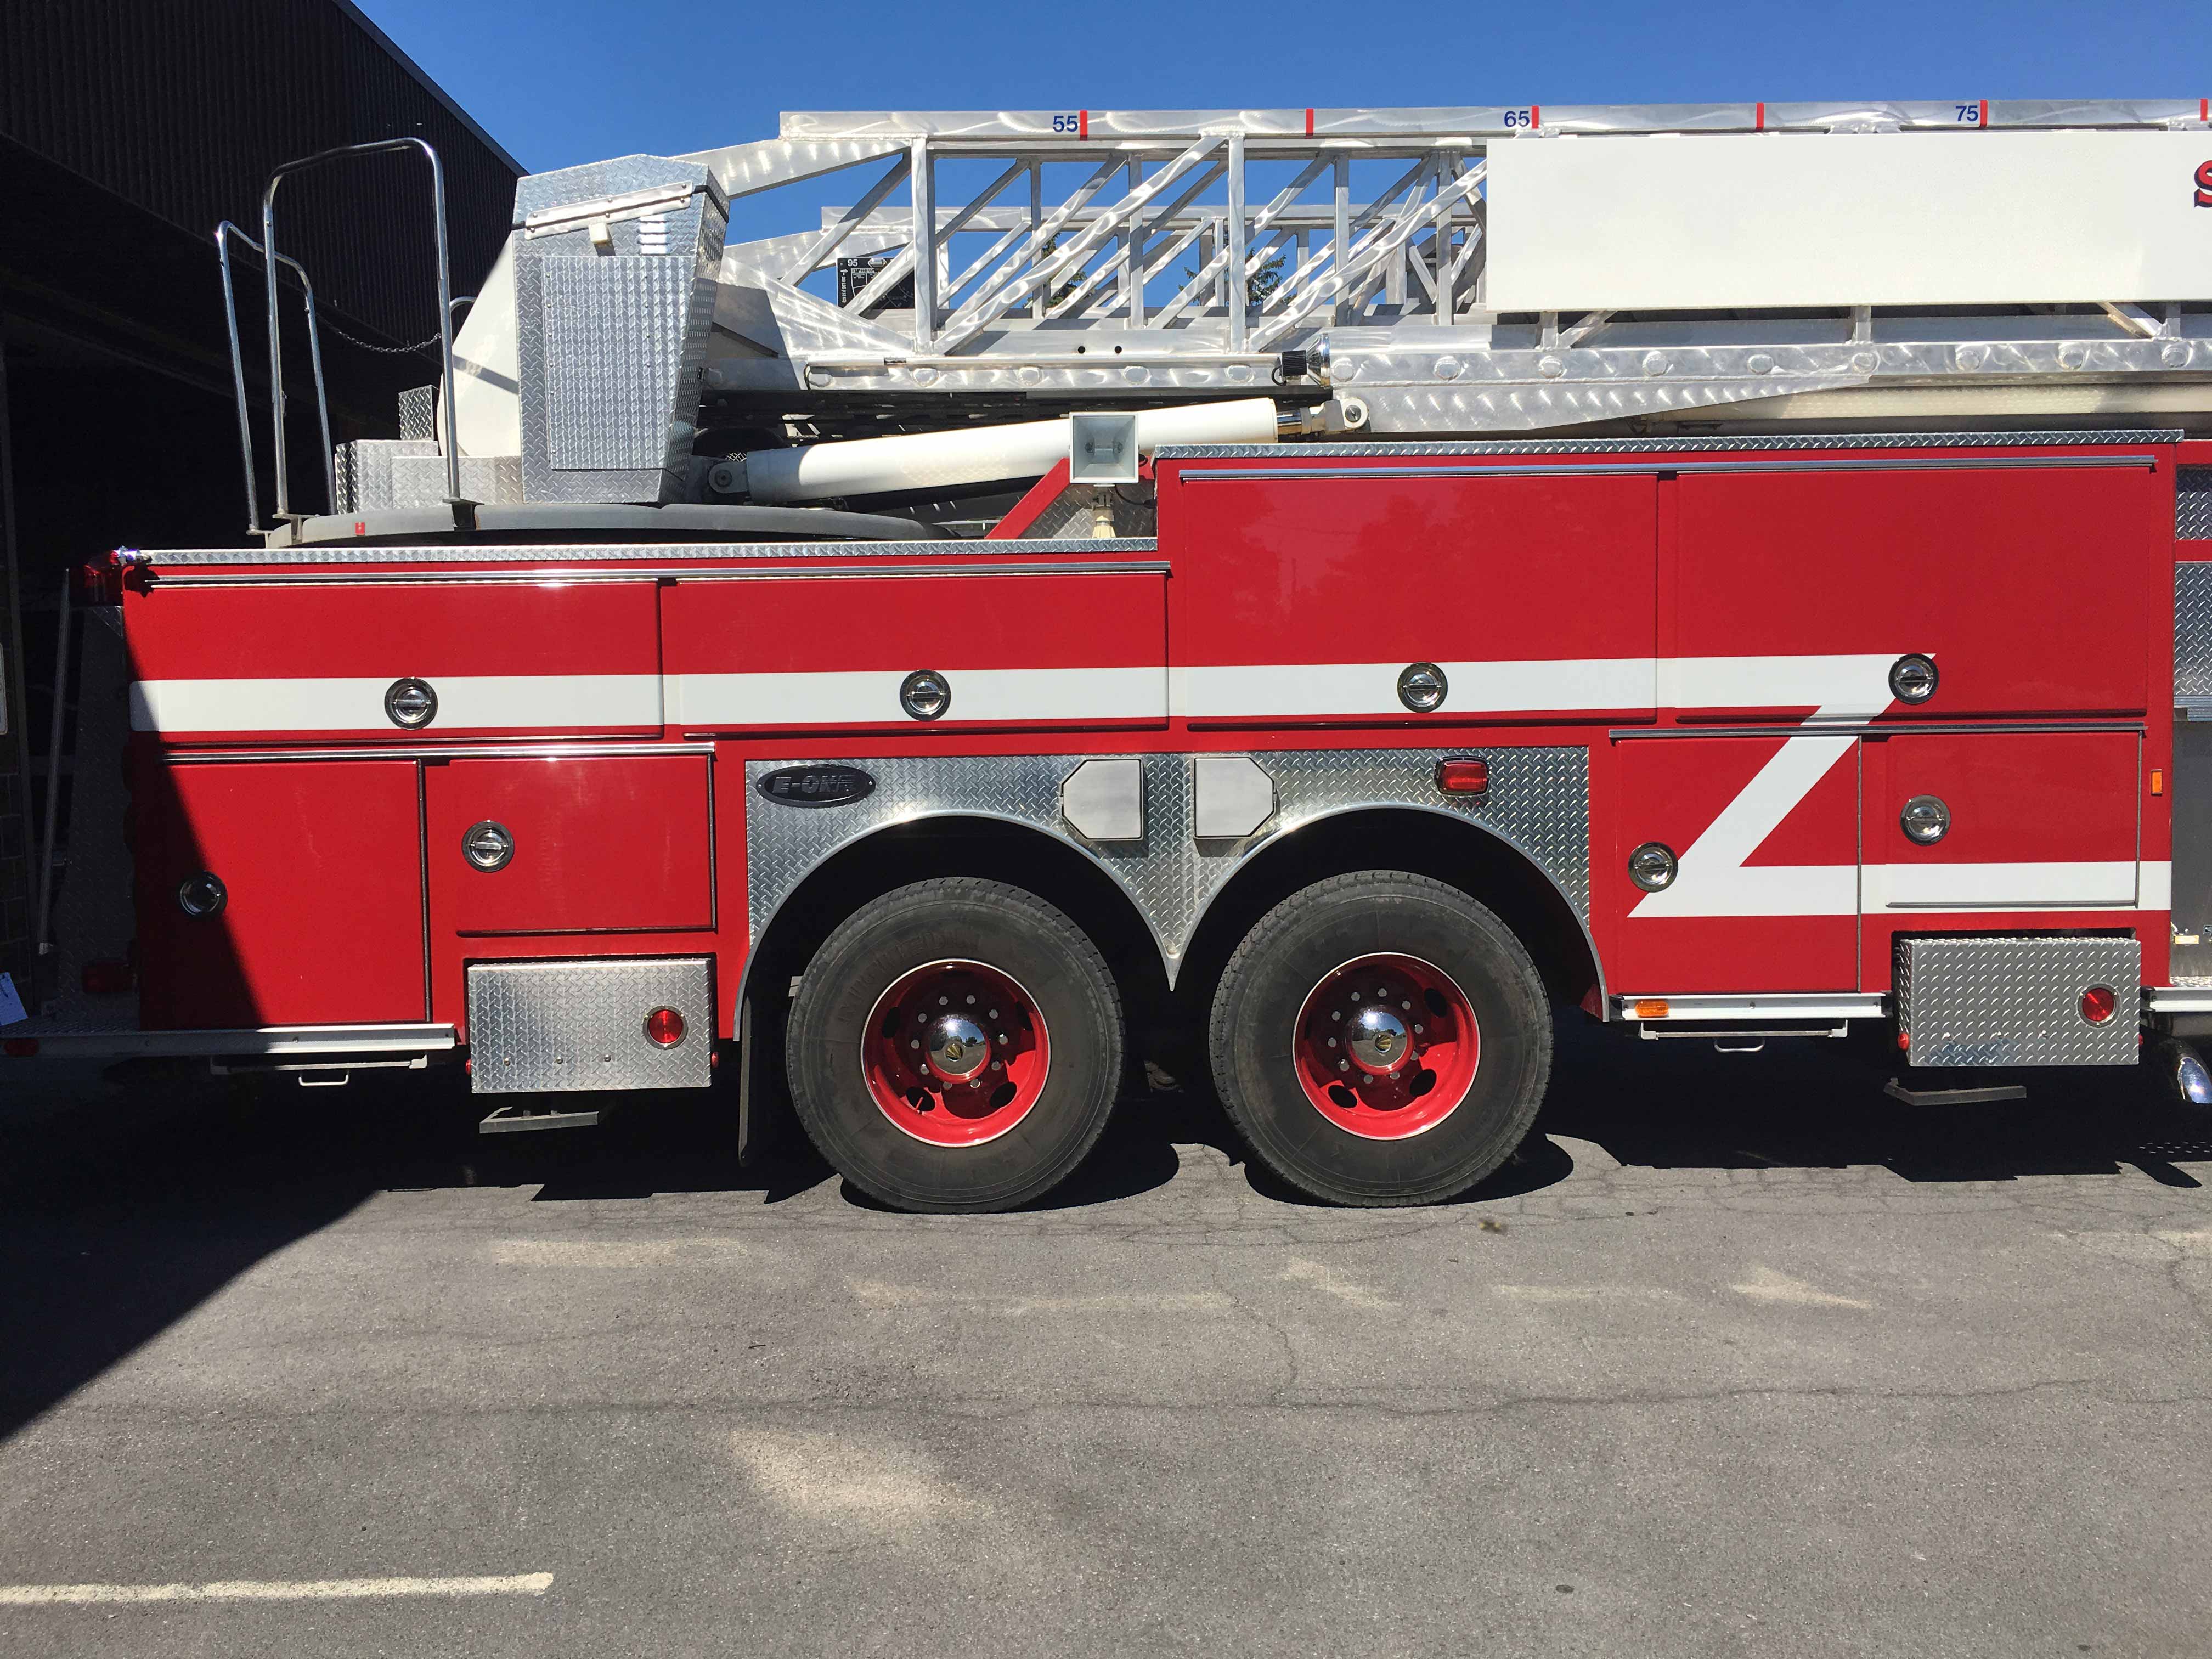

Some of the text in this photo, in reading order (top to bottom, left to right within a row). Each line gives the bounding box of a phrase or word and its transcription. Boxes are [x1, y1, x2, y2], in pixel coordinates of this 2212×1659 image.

[1504, 110, 1530, 127] 65
[1955, 105, 1978, 122] 75
[1053, 115, 1079, 132] 55
[847, 258, 858, 267] 95
[772, 775, 854, 793] E-ONE
